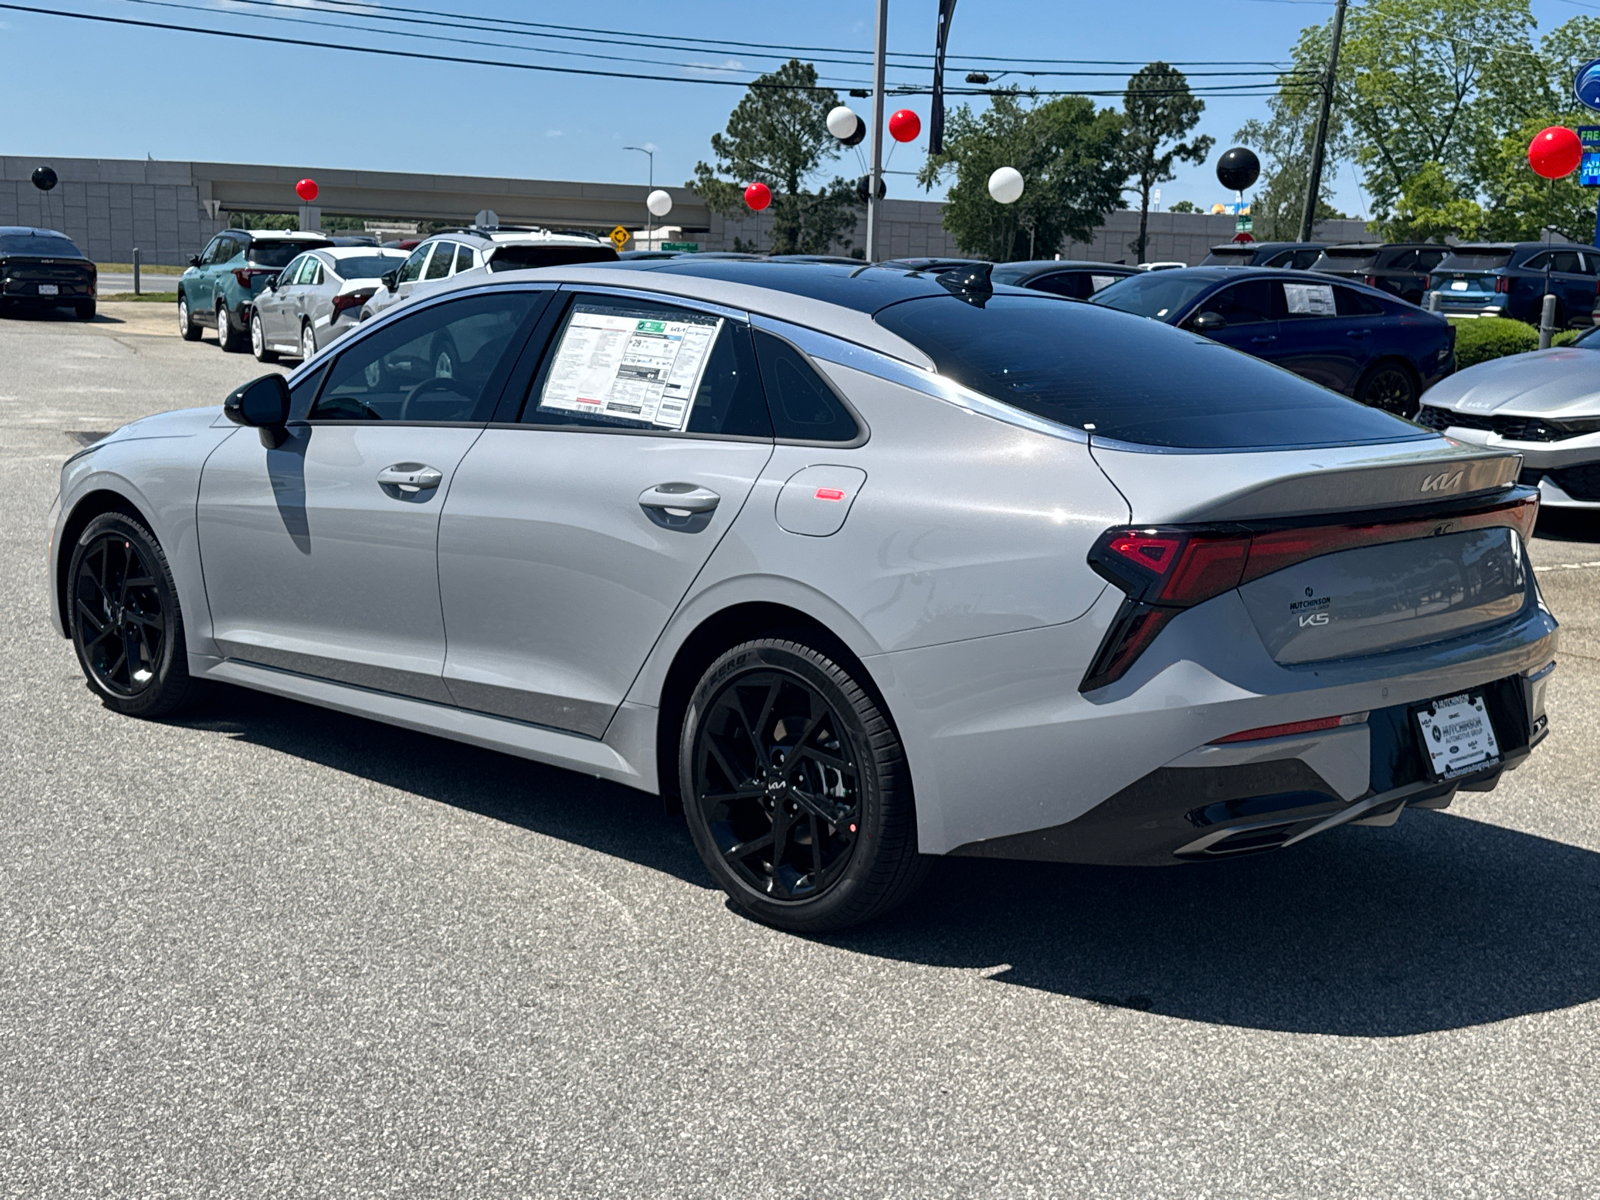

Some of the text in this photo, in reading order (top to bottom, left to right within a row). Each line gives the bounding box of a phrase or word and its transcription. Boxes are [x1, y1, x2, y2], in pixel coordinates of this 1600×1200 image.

[1580, 130, 1600, 142] FRE
[1420, 470, 1464, 493] KIA
[1289, 596, 1331, 610] HUTCHINSON
[1299, 612, 1330, 628] K5
[709, 653, 747, 686] ZERO
[1442, 716, 1482, 737] HUTCHINSON
[1445, 728, 1483, 744] AUTOMOTIVE GROUP
[768, 780, 787, 791] KIA
